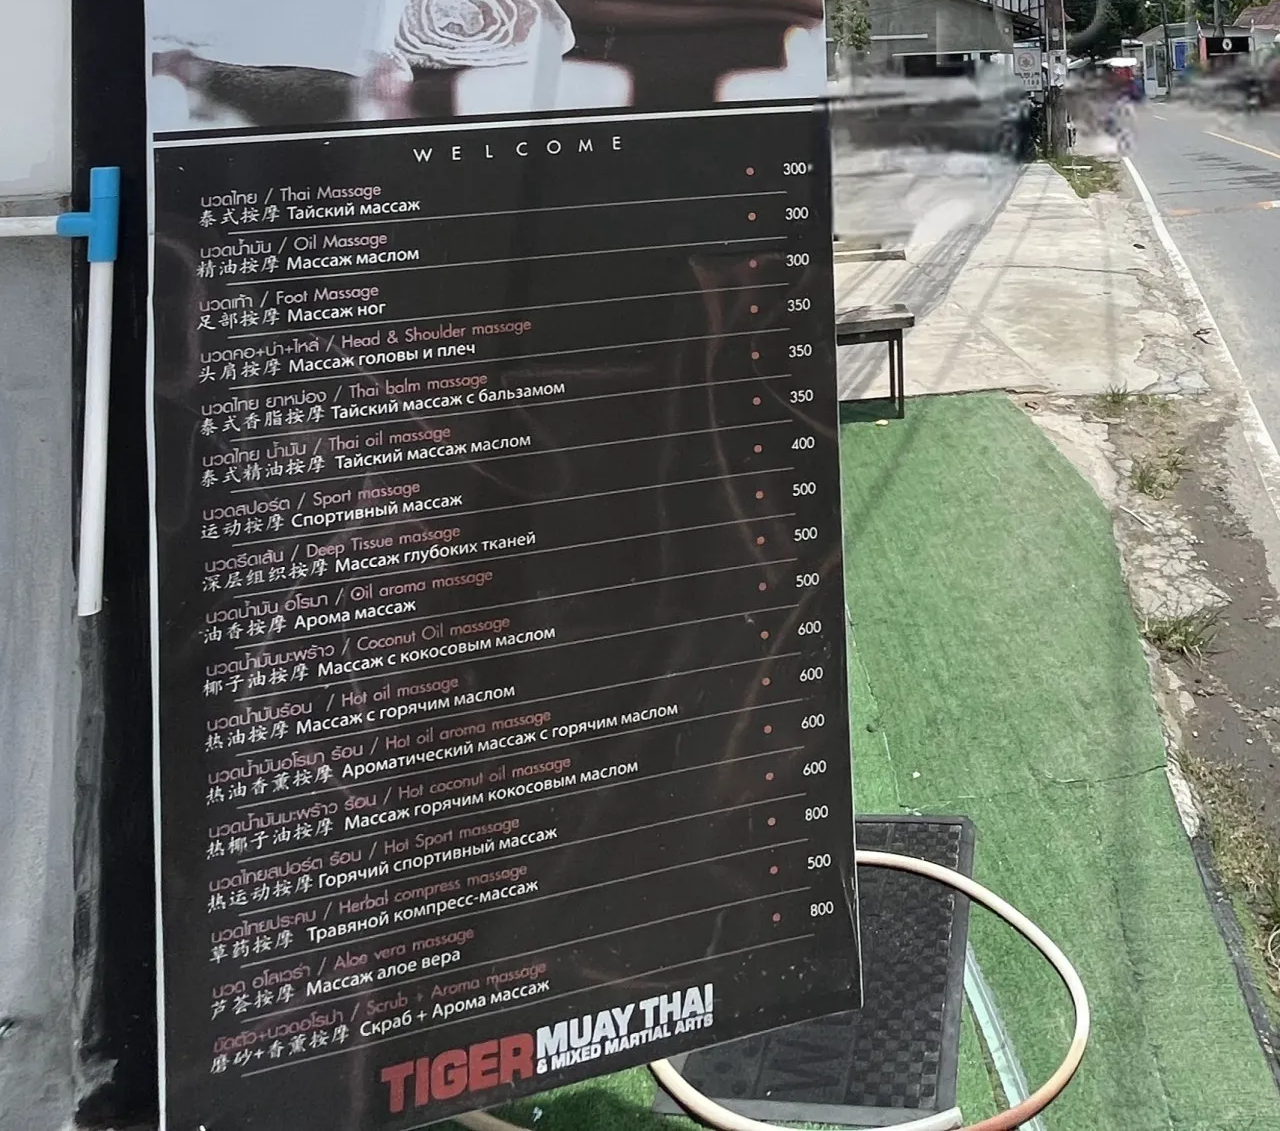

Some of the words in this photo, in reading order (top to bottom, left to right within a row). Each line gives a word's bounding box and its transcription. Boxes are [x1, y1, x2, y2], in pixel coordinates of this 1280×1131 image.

[413, 136, 623, 162] WELCOME
[784, 163, 806, 175] 300
[279, 185, 310, 201] Thai
[316, 185, 381, 200] Massage
[286, 202, 354, 219] Тайский
[359, 200, 420, 215] массаж
[786, 207, 808, 220] 300
[293, 233, 316, 250] Oil
[322, 234, 387, 248] Massage
[286, 254, 352, 270] Массаж
[356, 249, 419, 264] маслом
[786, 254, 809, 266] 300
[276, 290, 308, 304] Foot
[313, 286, 379, 301] Massage
[788, 298, 810, 311] 350
[287, 306, 353, 322] Массаж
[357, 303, 386, 316] ног
[341, 329, 380, 348] Head
[405, 322, 465, 342] Shoulder
[472, 320, 531, 335] massage
[288, 356, 354, 372] Массаж
[358, 349, 418, 365] головы
[437, 343, 475, 357] плеч
[789, 344, 812, 357] 350
[348, 382, 379, 398] Thai
[385, 377, 420, 394] balm
[427, 375, 487, 389] massage
[790, 390, 813, 403] 350
[329, 398, 398, 419] Тайский
[402, 394, 462, 411] массаж
[478, 383, 564, 402] бальзамом
[327, 434, 358, 451] Thai
[365, 429, 382, 446] oil
[389, 427, 450, 443] massage
[792, 437, 814, 449] 400
[334, 448, 402, 469] Тайский
[406, 443, 467, 460] массаж
[470, 435, 530, 452] маслом
[312, 489, 351, 508] Sport
[357, 483, 420, 499] massage
[793, 482, 816, 496] 500
[291, 500, 398, 527] Спортивный
[402, 494, 462, 512] массаж
[306, 543, 344, 558] Deep
[350, 536, 393, 550] Tissue
[399, 527, 460, 544] massage
[794, 527, 817, 541] 500
[335, 553, 399, 572] Массаж
[404, 542, 477, 563] глубоких
[480, 530, 535, 550] тканей
[349, 582, 372, 601] Oil
[378, 580, 425, 596] aroma
[431, 571, 493, 588] massage
[796, 573, 819, 587] 500
[293, 610, 350, 631] Арома
[354, 600, 416, 619] массаж
[356, 630, 416, 650] Coconut
[421, 622, 443, 641] Oil
[449, 617, 510, 635] massage
[798, 621, 821, 635] 600
[317, 656, 383, 677] Массаж
[400, 638, 491, 663] кокосовым
[495, 627, 555, 646] маслом
[800, 667, 823, 681] 600
[341, 689, 366, 708] Hot
[372, 682, 390, 701] oil
[396, 678, 458, 697] massage
[296, 712, 362, 734] Массаж
[379, 697, 449, 719] горячим
[453, 685, 514, 706] маслом
[802, 714, 824, 729] 600
[341, 740, 473, 779] Ароматический
[477, 730, 536, 752] массаж
[552, 716, 617, 737] горячим
[620, 704, 677, 724] маслом
[385, 734, 410, 750] Hot
[416, 726, 433, 744] oil
[438, 723, 485, 739] aroma
[491, 711, 551, 730] massage
[398, 783, 423, 800] Hot
[429, 772, 483, 793] coconut
[488, 764, 505, 781] oil
[511, 757, 570, 777] massage
[803, 760, 826, 775] 600
[344, 807, 410, 830] Массаж
[414, 792, 483, 816] горячим
[488, 774, 576, 801] кокосовым
[580, 761, 638, 782] маслом
[805, 805, 828, 821] 800
[318, 860, 388, 888] Горячий
[392, 838, 494, 871] спортивный
[498, 827, 557, 849] массаж
[808, 854, 831, 869] 500
[306, 910, 389, 943] Травяной
[393, 880, 538, 922] компресс-массаж
[811, 901, 833, 916] 800
[305, 967, 373, 998] Массаж
[376, 959, 418, 980] алое
[421, 949, 460, 968] вера
[359, 1009, 411, 1036] Скраб
[431, 995, 486, 1019] Арома
[490, 979, 549, 1003] массаж
[380, 1034, 534, 1113] TIGER
[536, 1000, 637, 1059] MUAY
[638, 984, 714, 1032] THAI
[551, 1044, 602, 1071] MIXED
[604, 1029, 672, 1056] MARTIAL
[674, 1014, 714, 1038] ARTS
